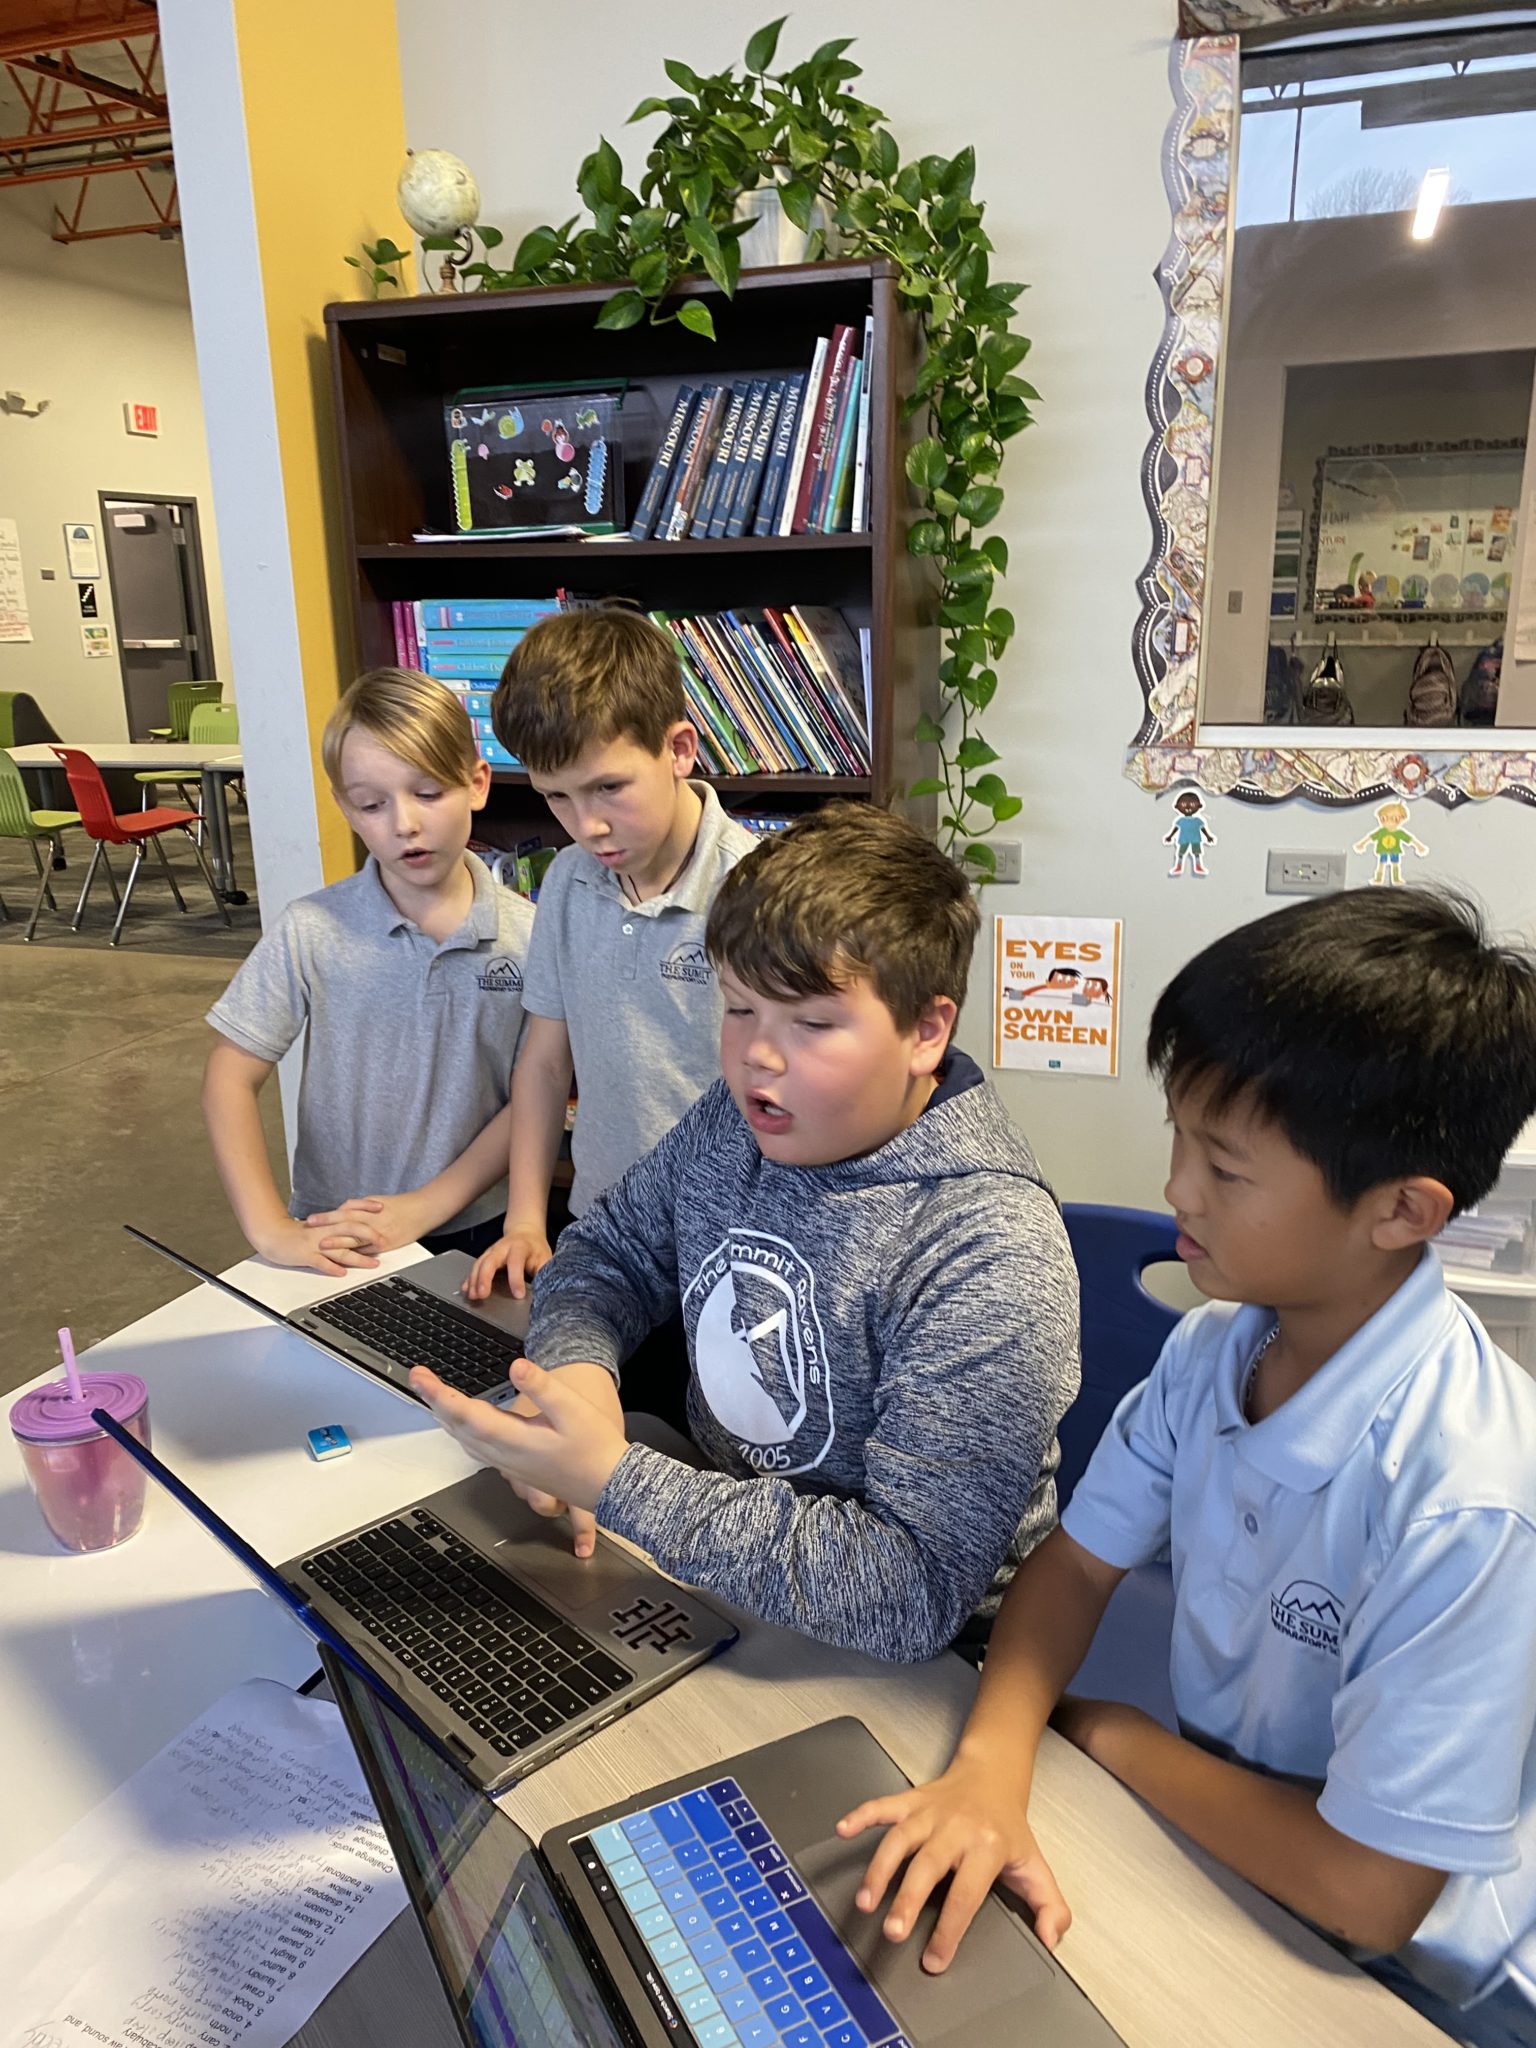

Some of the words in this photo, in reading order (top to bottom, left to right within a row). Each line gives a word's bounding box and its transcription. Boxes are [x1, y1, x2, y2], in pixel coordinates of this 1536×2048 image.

[134, 404, 157, 430] EXIT
[776, 384, 799, 457] MISSOURI
[659, 399, 689, 468] MISSOURI
[717, 394, 744, 465] MISSOURI
[735, 392, 762, 463] MISSOURI
[752, 391, 780, 462] MISSOURI
[1006, 940, 1102, 961] EYES
[478, 978, 493, 986] THE
[1010, 970, 1035, 979] YOUR
[1004, 1007, 1073, 1025] OWN
[1004, 1023, 1108, 1046] SCREEN
[694, 1258, 728, 1296] The
[797, 1278, 820, 1385] Ravens
[353, 1837, 389, 1855] challenge
[355, 1851, 393, 1873] Challenge
[323, 1866, 361, 1887] traditional
[304, 1887, 342, 1906] disappear
[328, 1883, 352, 1896] willow
[304, 1902, 333, 1916] custom
[295, 1912, 323, 1929] folklore
[770, 1922, 779, 1931] M
[292, 1926, 313, 1938] dawn
[278, 1935, 304, 1949] pause
[270, 1948, 297, 1963] taught
[787, 1948, 795, 1957] N
[260, 1960, 287, 1973] author
[719, 1970, 728, 1978] U
[246, 1968, 276, 1988] laundry
[764, 1976, 772, 1984] H
[804, 1976, 813, 1984] B
[241, 1983, 265, 1998] crawl
[652, 1983, 661, 1996] type
[233, 1995, 254, 2012] book
[661, 2000, 673, 2020] Search
[781, 2005, 790, 2013] G
[822, 2006, 830, 2014] V
[63, 2015, 82, 2027] and
[222, 2008, 243, 2022] once
[81, 2024, 110, 2043] sound,
[210, 2019, 232, 2034] north
[198, 2032, 220, 2046] carry
[841, 2034, 850, 2043] C
